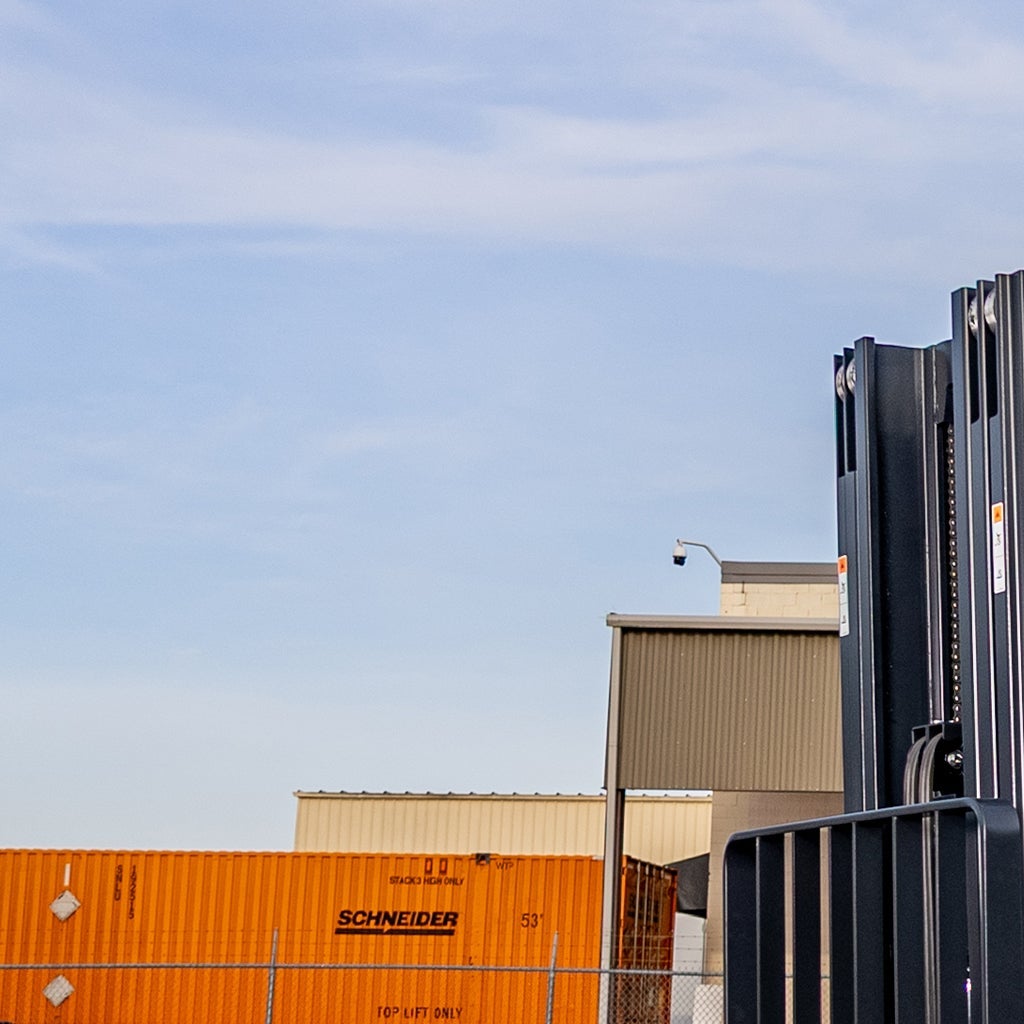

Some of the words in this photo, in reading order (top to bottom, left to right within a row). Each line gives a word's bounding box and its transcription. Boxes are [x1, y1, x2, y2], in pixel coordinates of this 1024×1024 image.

[389, 876, 415, 885] STACK
[444, 876, 465, 886] ONLY
[338, 910, 459, 927] SCHNEIDER
[378, 1006, 400, 1018] TOP
[404, 1007, 428, 1019] LIFT
[434, 1007, 462, 1019] ONLY
